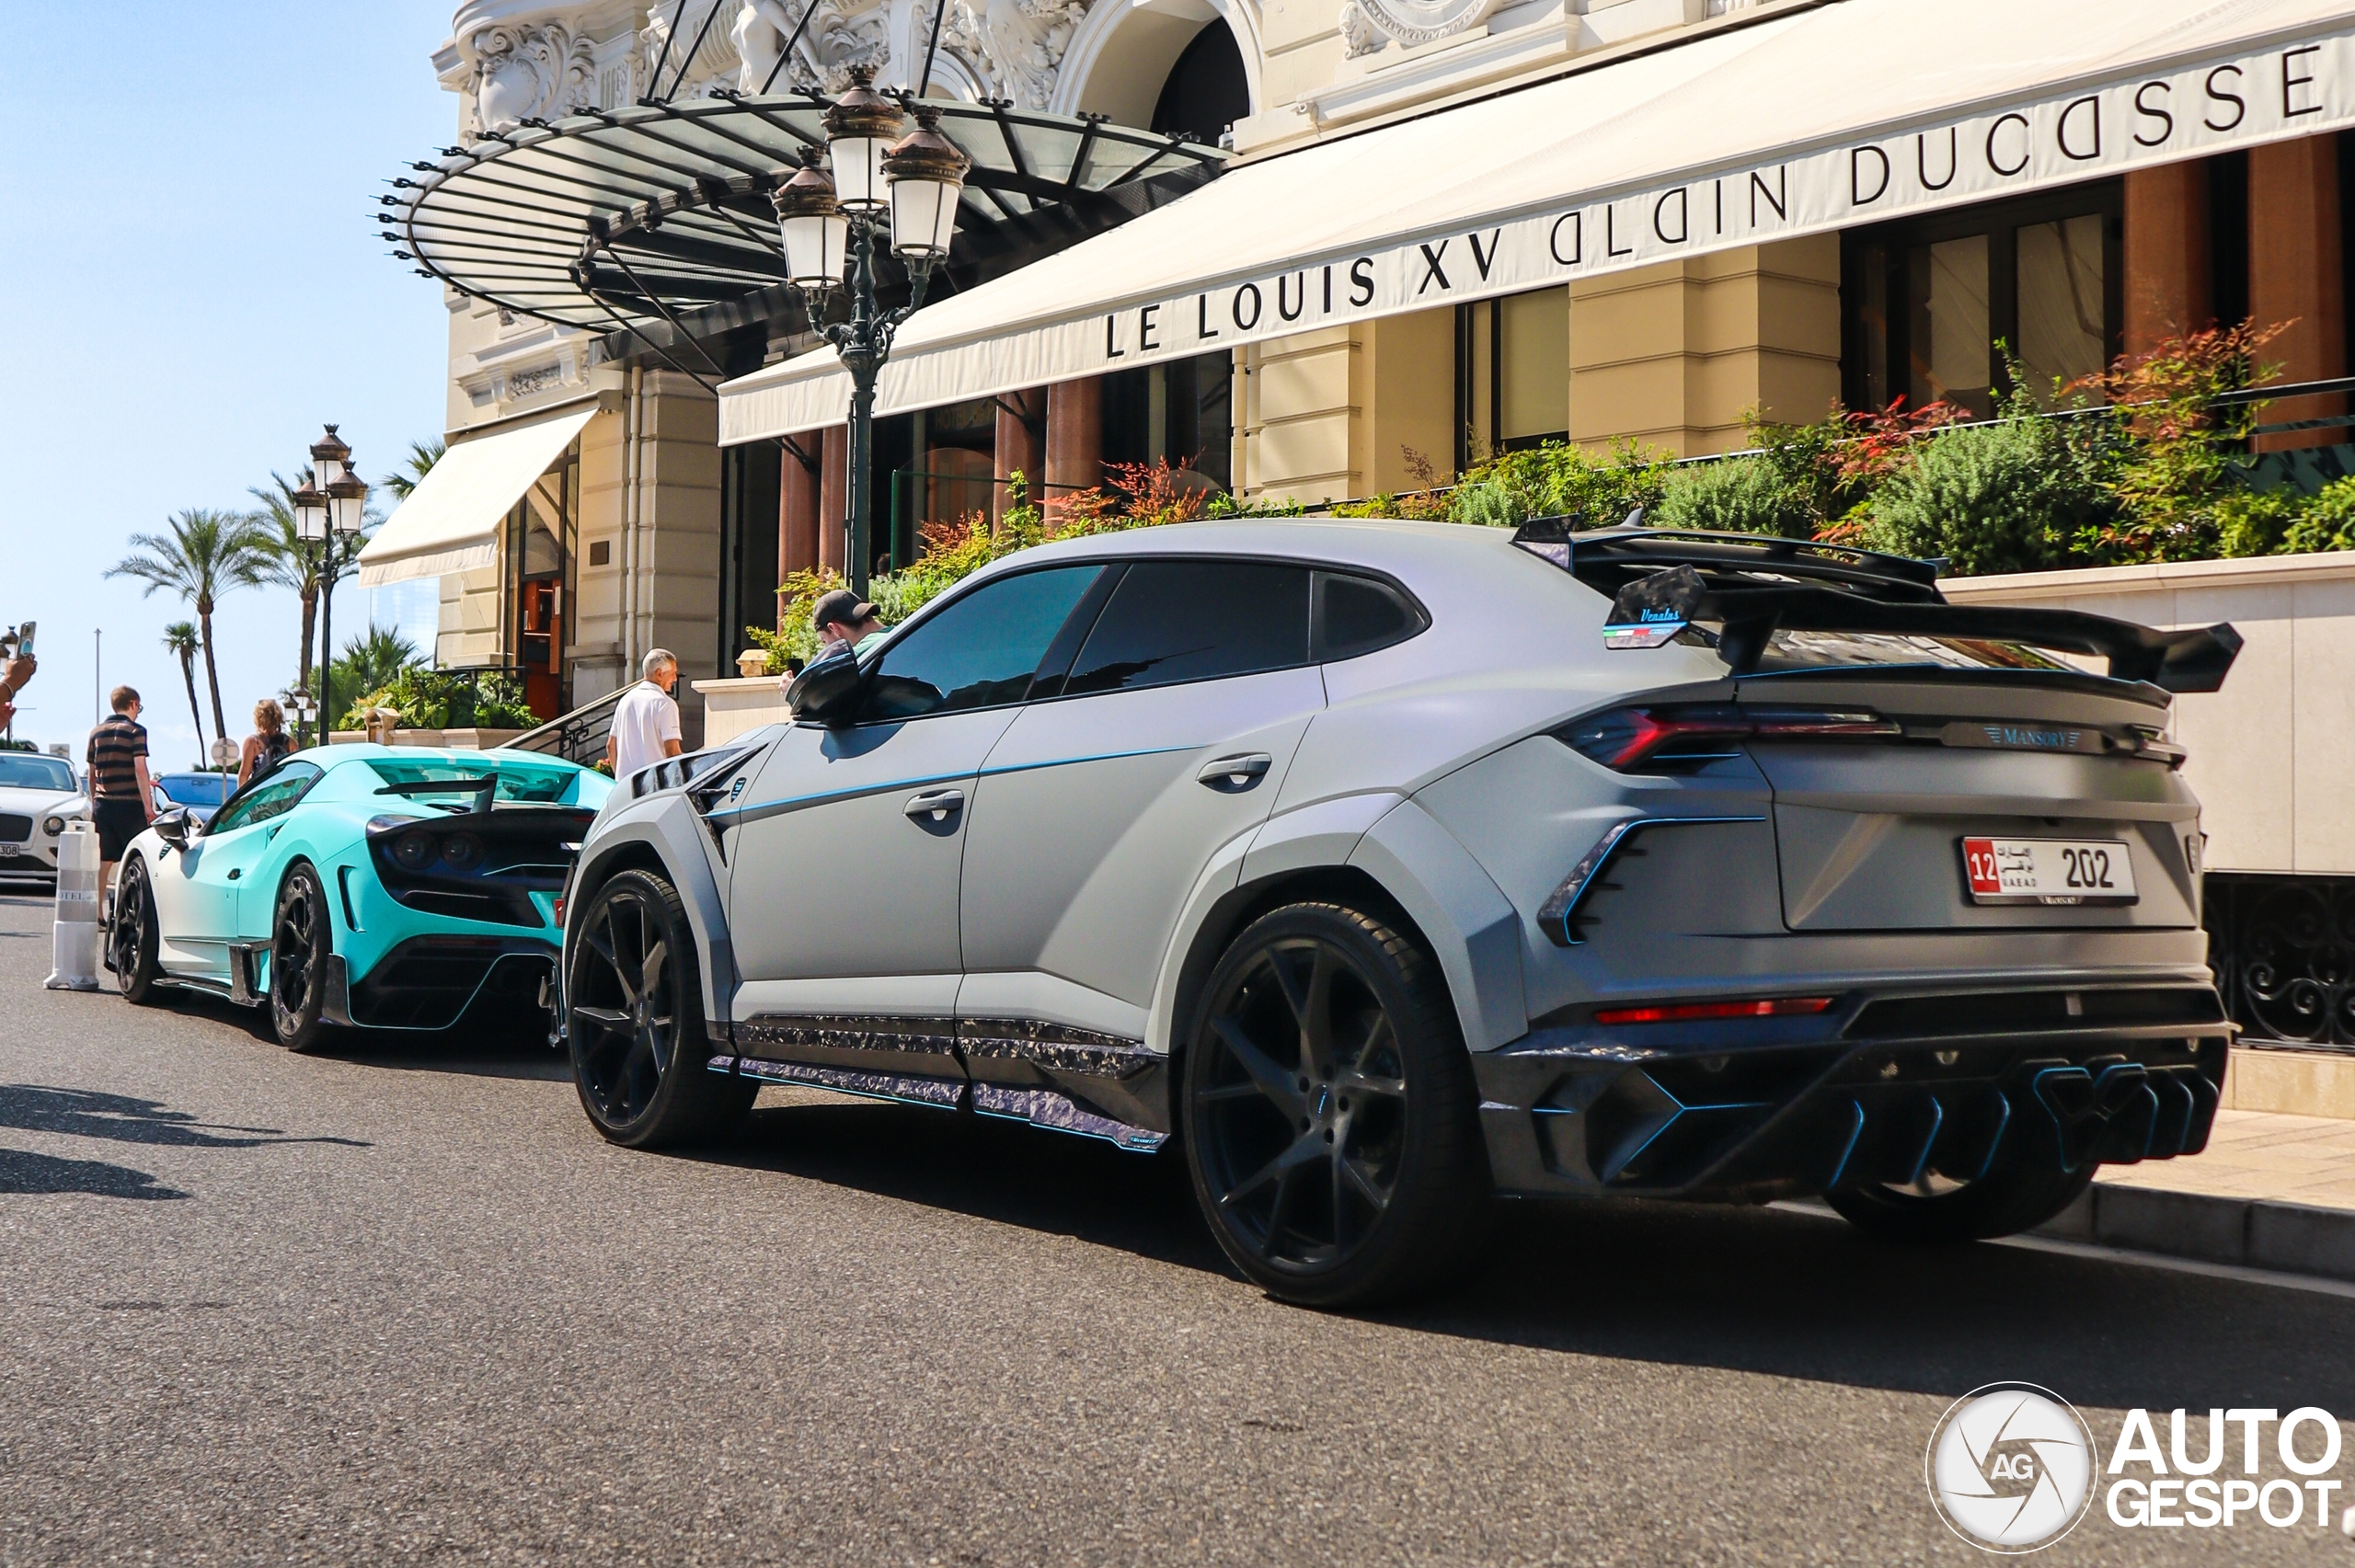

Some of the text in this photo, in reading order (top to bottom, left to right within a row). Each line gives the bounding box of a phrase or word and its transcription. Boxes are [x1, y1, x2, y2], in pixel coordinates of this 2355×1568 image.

[1106, 304, 1161, 359] LE
[1198, 257, 1376, 339] LOUIS
[1419, 228, 1501, 294] XV
[0, 845, 17, 856] 308
[1970, 853, 1997, 881] 12
[2062, 849, 2113, 887] 202
